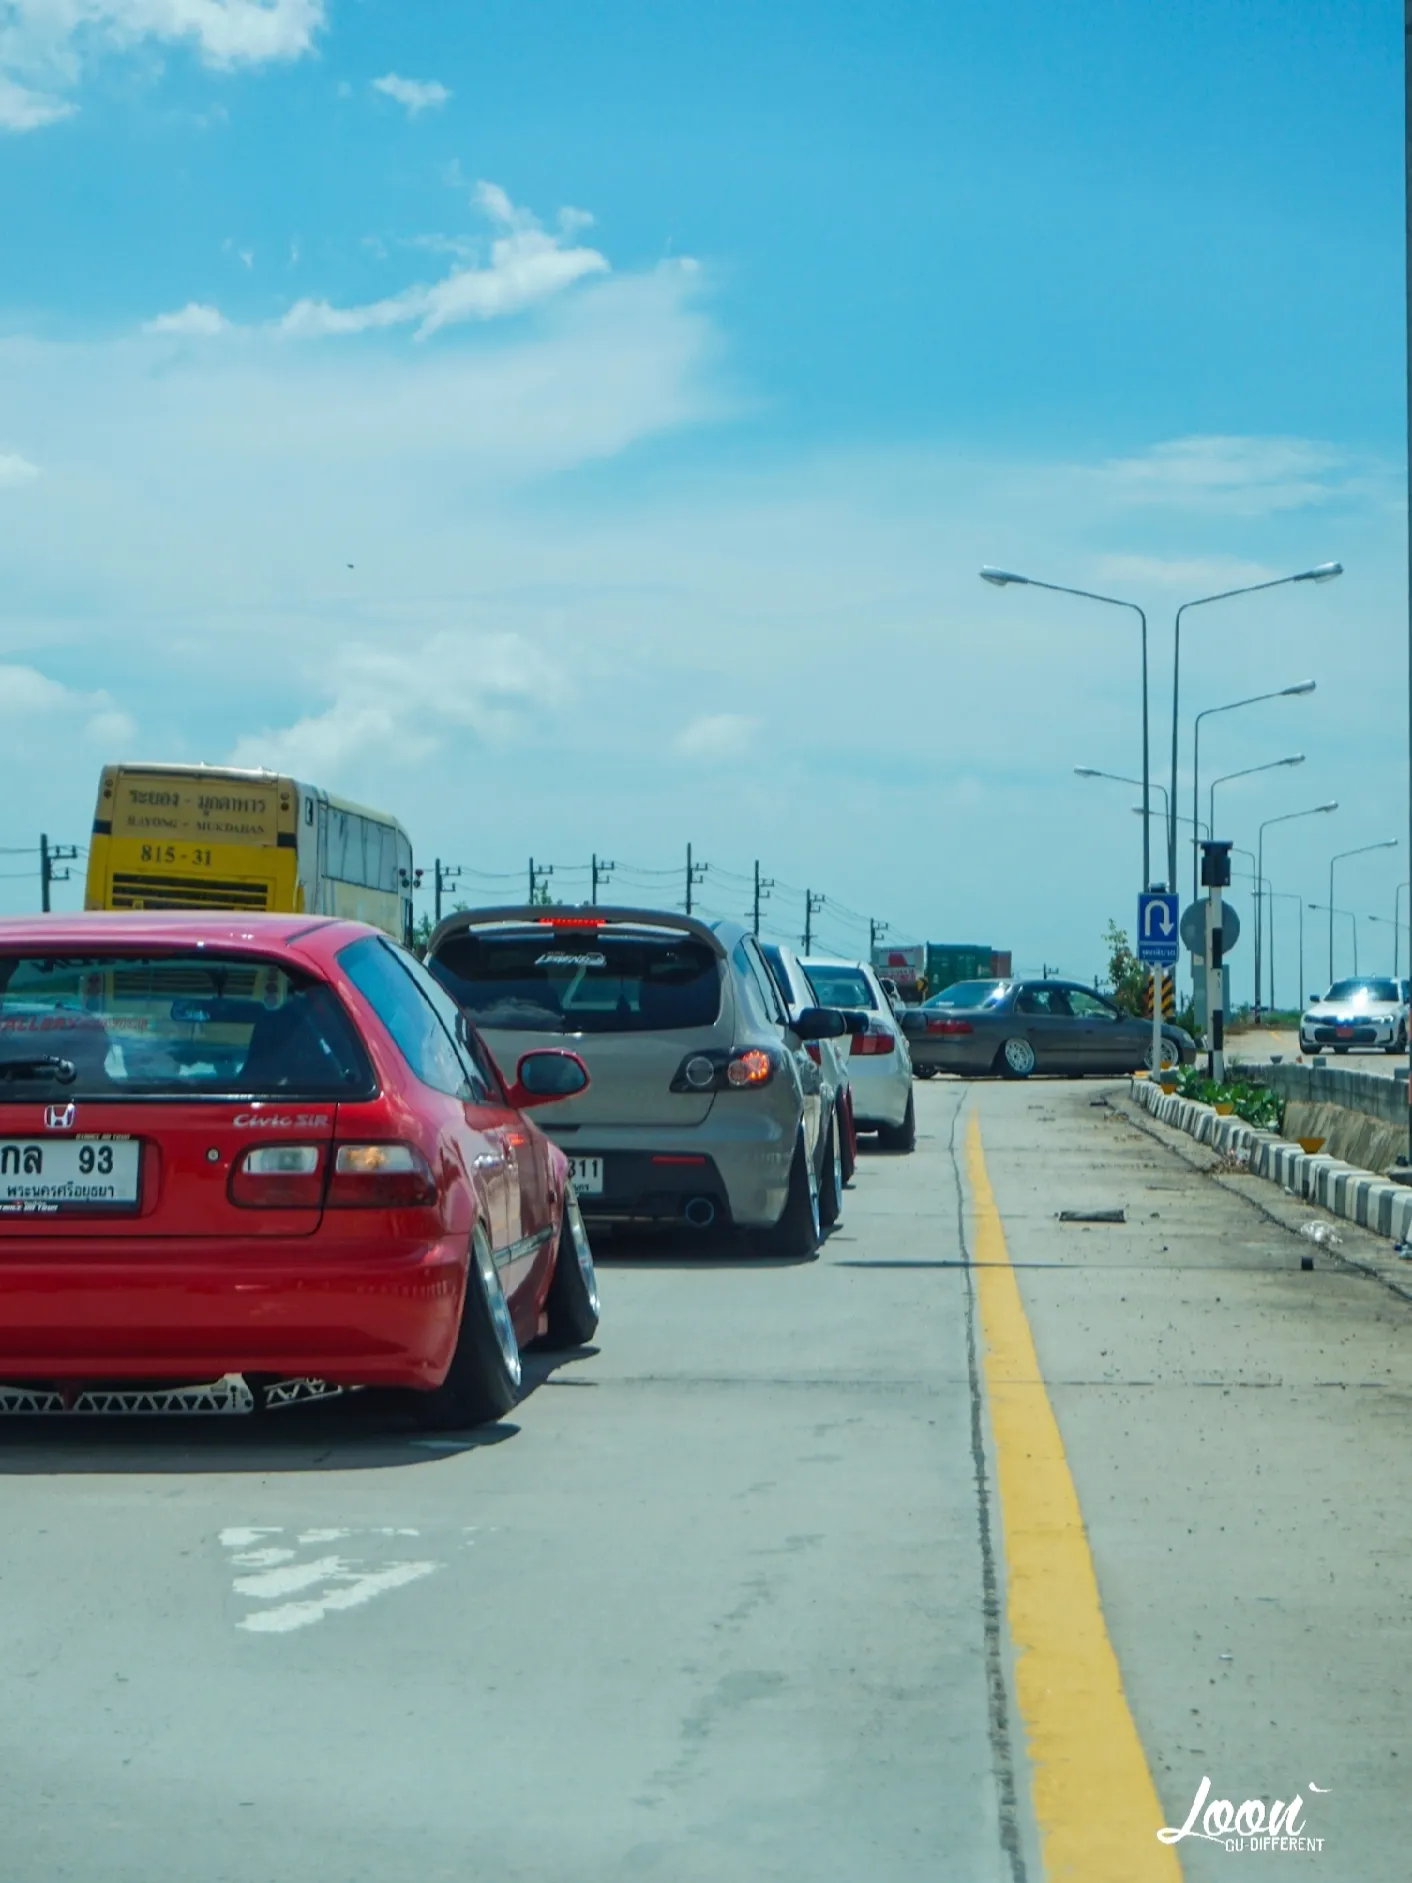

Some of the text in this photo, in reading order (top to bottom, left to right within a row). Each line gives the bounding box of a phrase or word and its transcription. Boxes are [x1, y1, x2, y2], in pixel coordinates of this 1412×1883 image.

[196, 821, 264, 834] MUKDAHAN
[232, 1113, 293, 1129] Civic
[79, 1145, 114, 1175] 93
[7, 1180, 115, 1202] พระนครศรีอยุธยา
